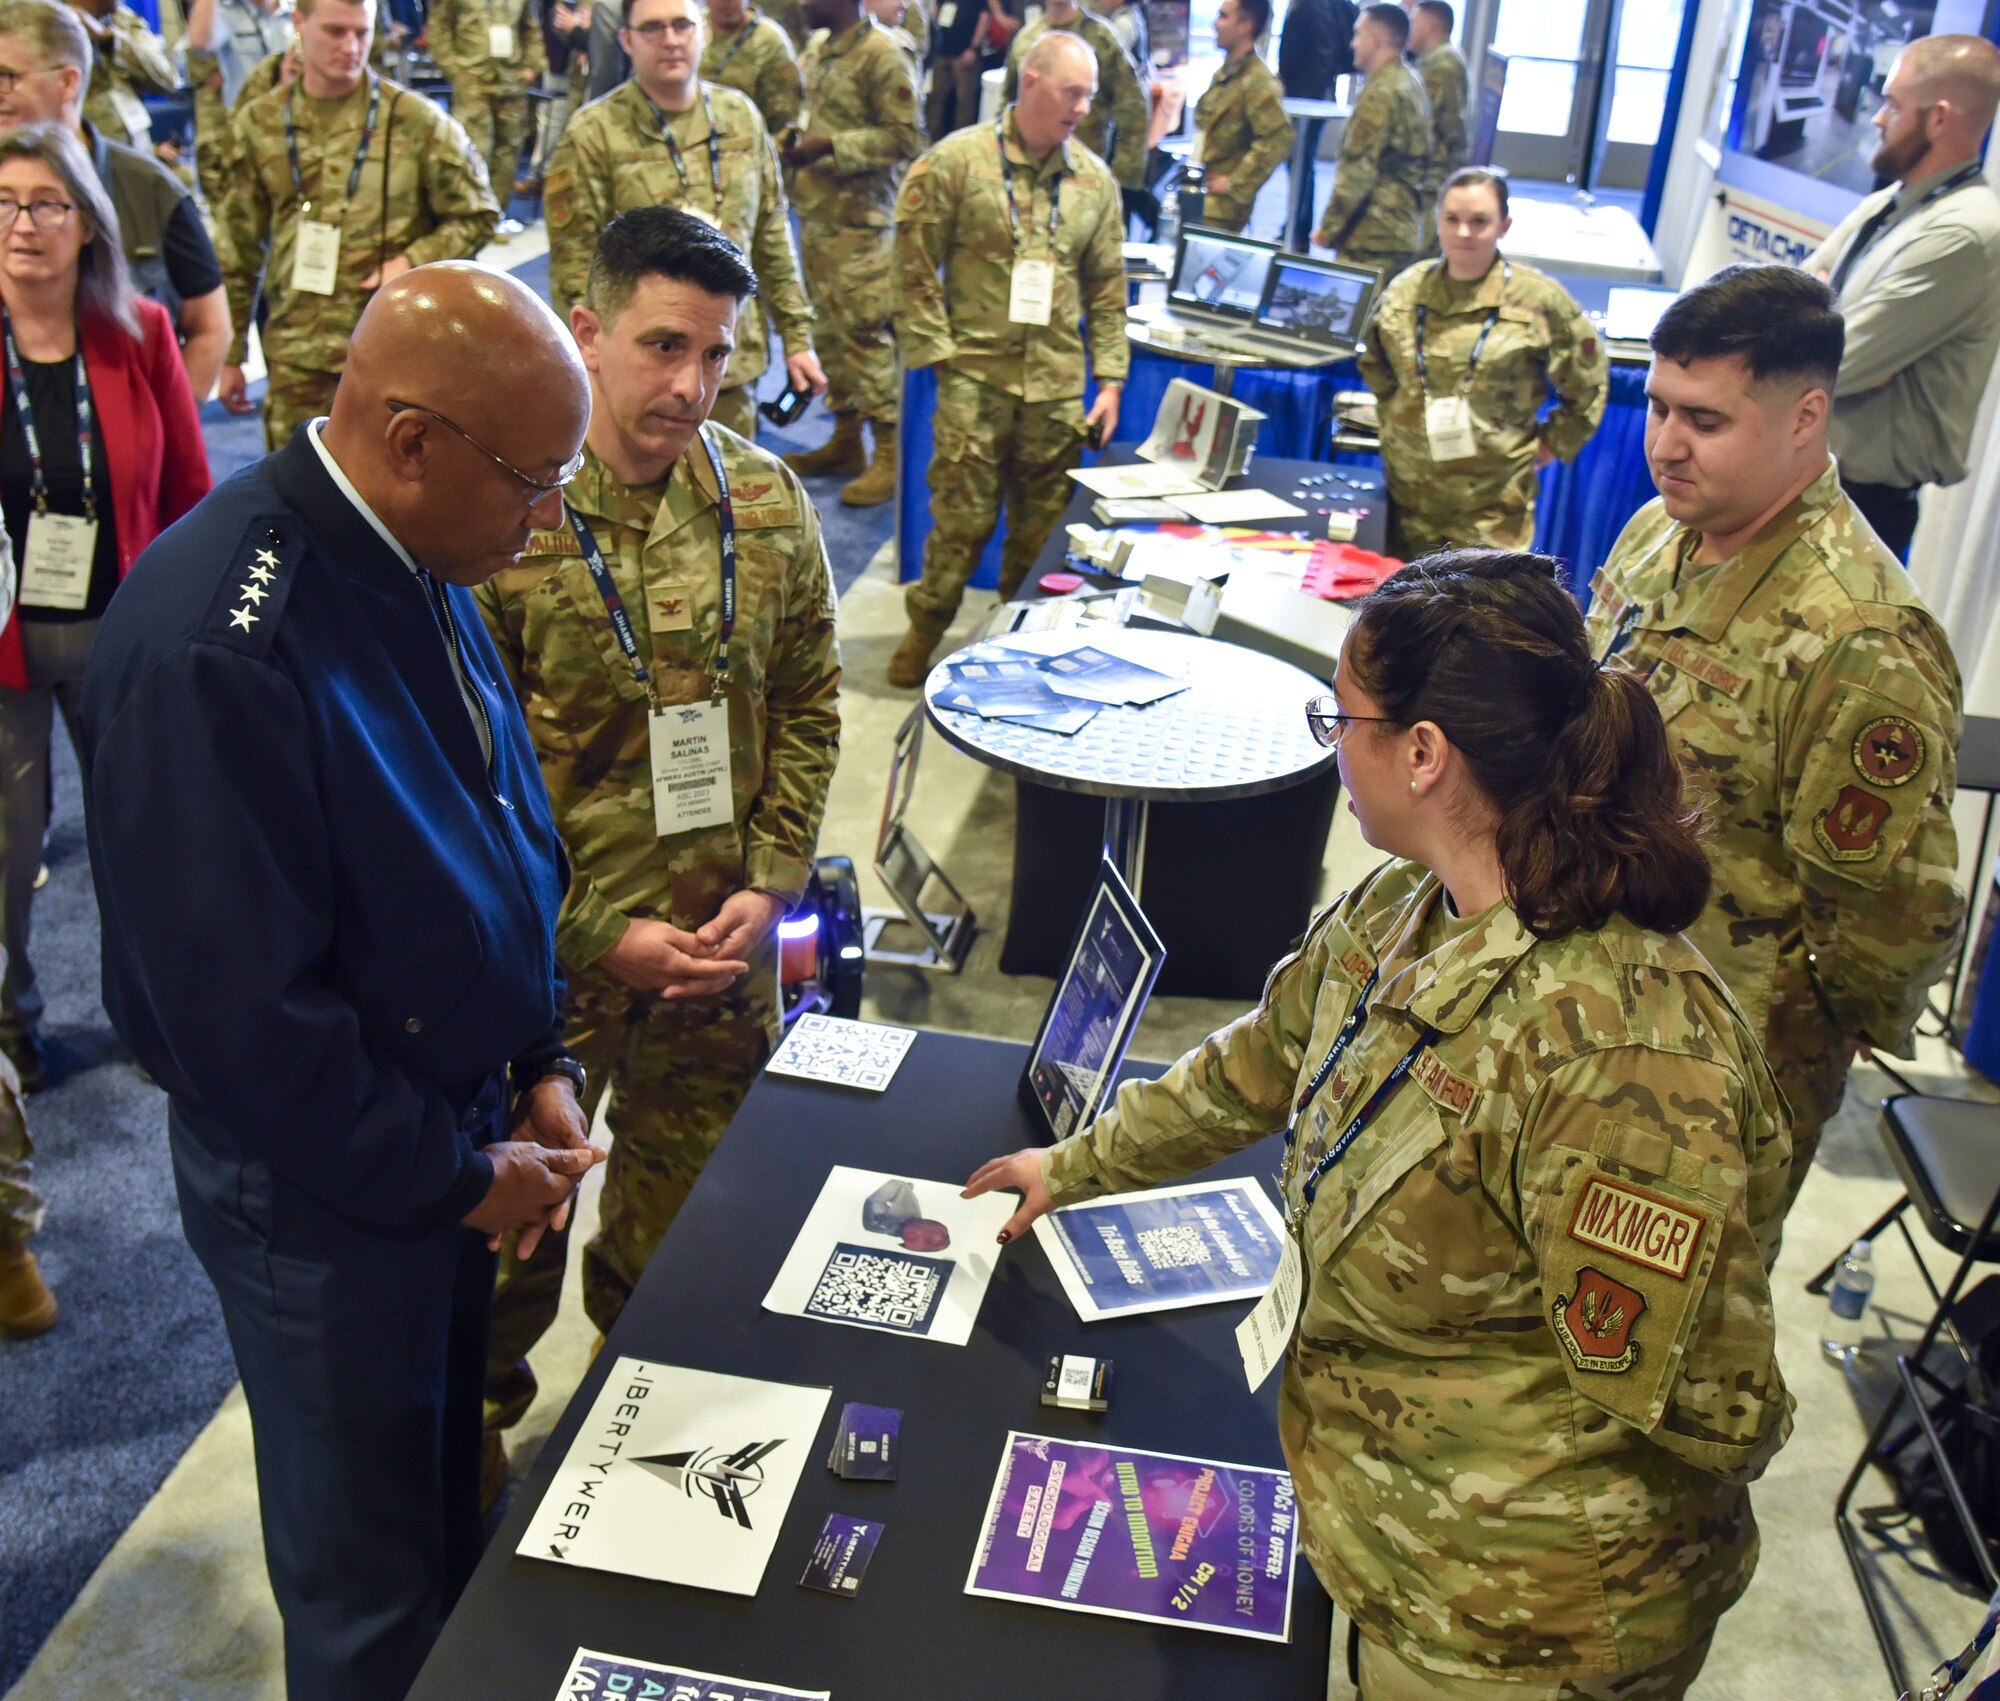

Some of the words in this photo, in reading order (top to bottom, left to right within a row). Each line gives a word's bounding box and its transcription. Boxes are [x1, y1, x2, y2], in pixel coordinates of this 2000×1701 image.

[613, 610, 637, 654] L3HARRIS
[670, 746, 710, 760] SALINAS
[672, 735, 707, 748] MARTIN
[1340, 944, 1373, 989] LOPE
[1309, 1035, 1346, 1087] L3HARRIS
[1581, 1188, 1690, 1266] MXMGR
[1599, 1355, 1631, 1370] EUROPE
[1018, 1487, 1041, 1537] SAFETY
[1028, 1462, 1065, 1571] PSYCHOLOGICAL
[1237, 1480, 1255, 1535] COLORS
[1076, 1527, 1102, 1561] DESIGN
[1169, 1514, 1201, 1561] ENIGMA
[1238, 1539, 1255, 1558] OF
[1265, 1535, 1286, 1579] OFFER:
[1061, 1558, 1090, 1599] THINKING
[1190, 1561, 1216, 1588] CPI
[1236, 1562, 1254, 1616] MONEY
[1171, 1584, 1199, 1611] 1/2
